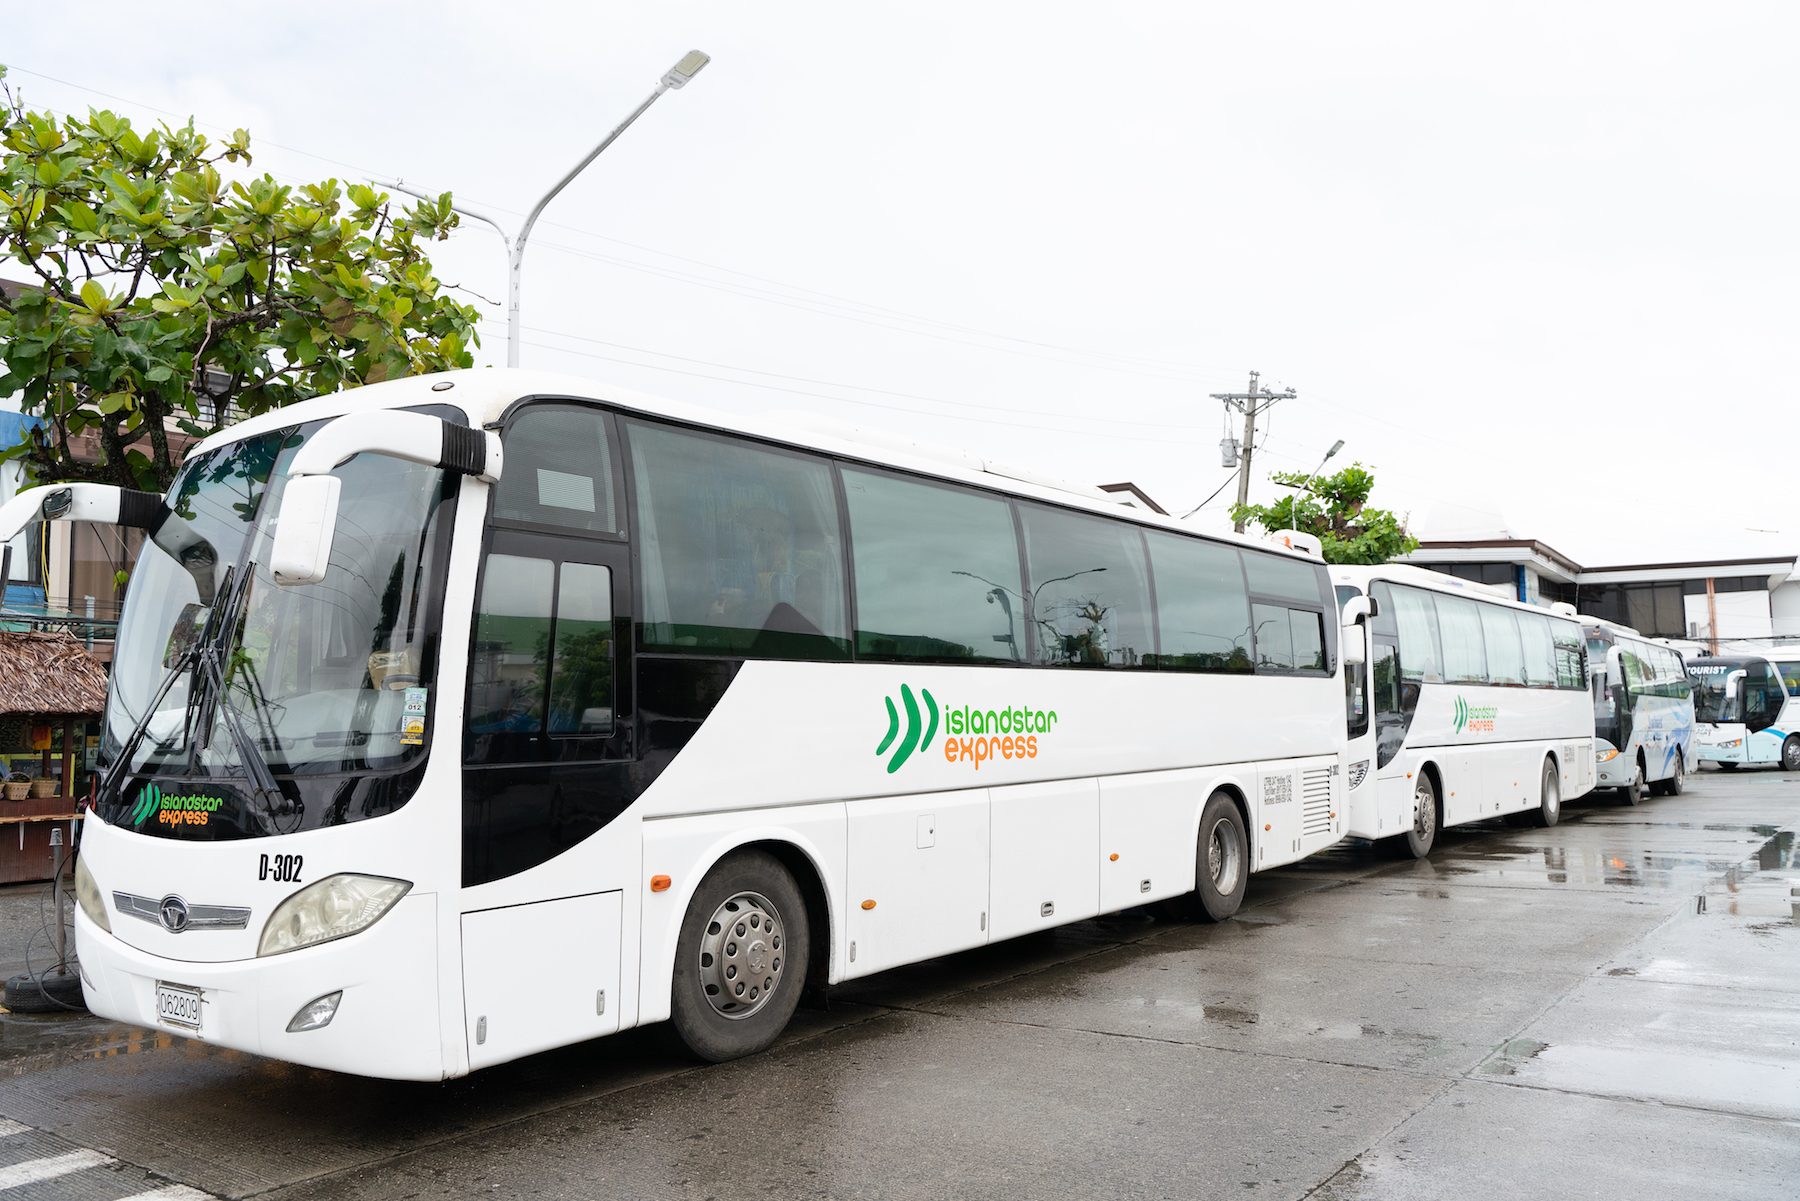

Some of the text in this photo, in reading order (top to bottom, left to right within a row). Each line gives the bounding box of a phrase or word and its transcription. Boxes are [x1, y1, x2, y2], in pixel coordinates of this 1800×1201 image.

[945, 704, 1058, 735] islandstar
[1468, 720, 1494, 736] express
[944, 735, 1038, 771] express
[160, 793, 223, 812] islandstar
[159, 809, 209, 829] express
[259, 853, 303, 883] D-302
[160, 992, 198, 1020] 062809
